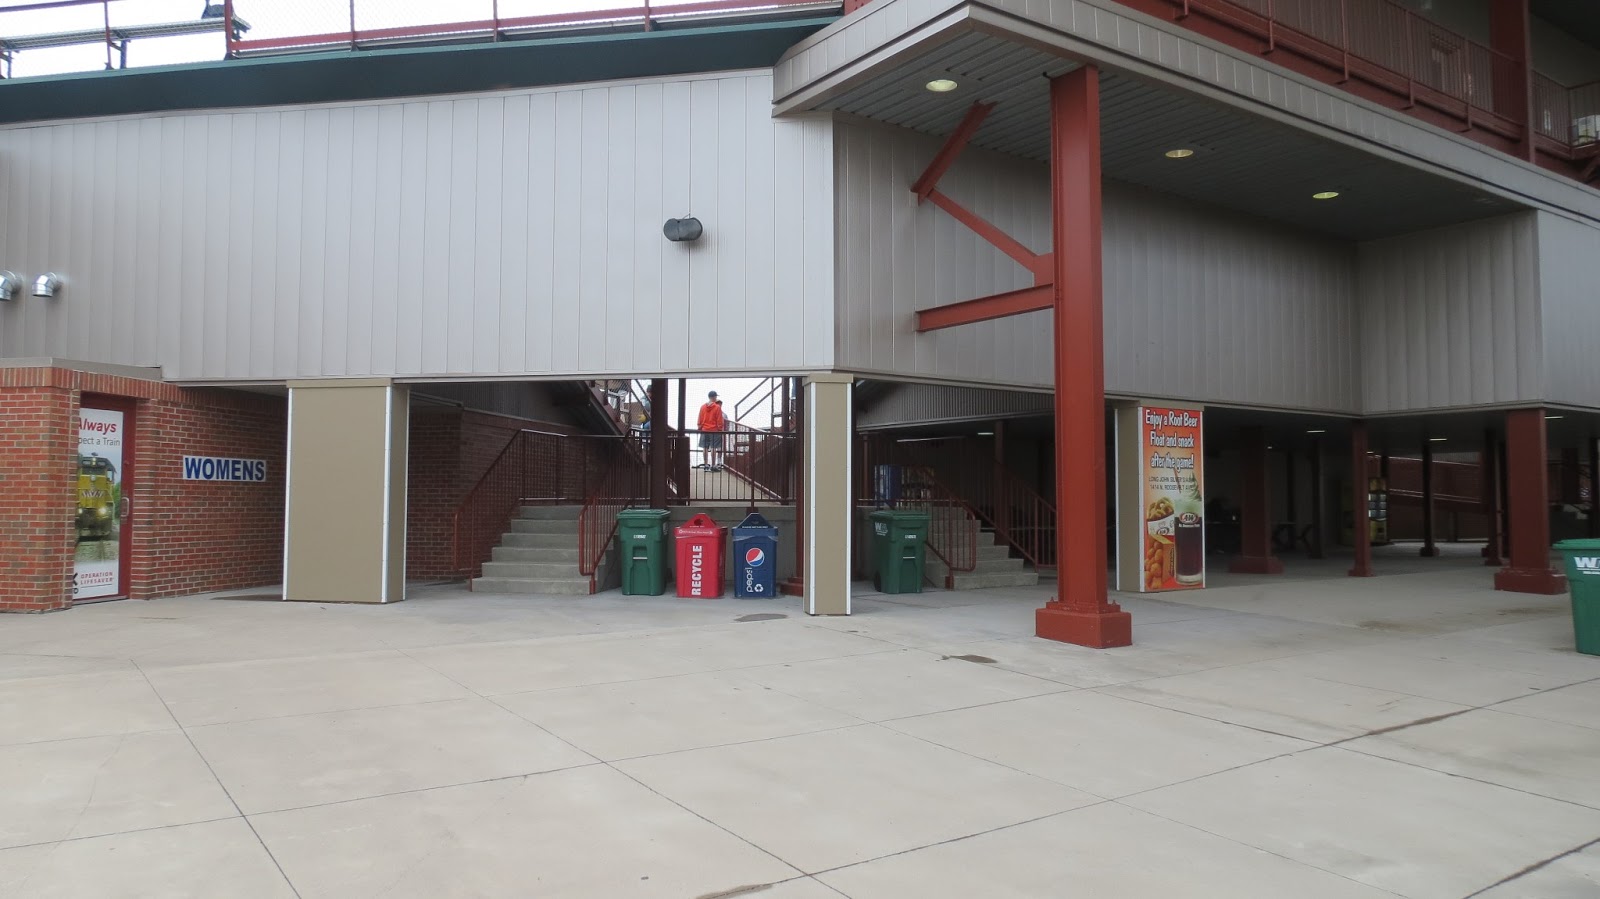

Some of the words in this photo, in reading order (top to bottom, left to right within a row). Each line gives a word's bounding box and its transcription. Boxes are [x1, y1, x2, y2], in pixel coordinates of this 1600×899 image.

[1146, 409, 1163, 430] Enjoy
[1164, 416, 1168, 426] a
[1168, 411, 1182, 426] Root
[1184, 412, 1198, 427] Beer
[78, 437, 94, 446] pect
[102, 436, 120, 446] Train
[1150, 430, 1164, 446] Float
[1166, 432, 1177, 446] and
[1178, 433, 1194, 448] snack
[184, 457, 265, 481] WOMENS
[1150, 452, 1164, 467] after
[1165, 453, 1174, 468] the
[1176, 454, 1194, 472] game!
[692, 545, 702, 596] RECYCLE
[745, 567, 754, 592] pepsi
